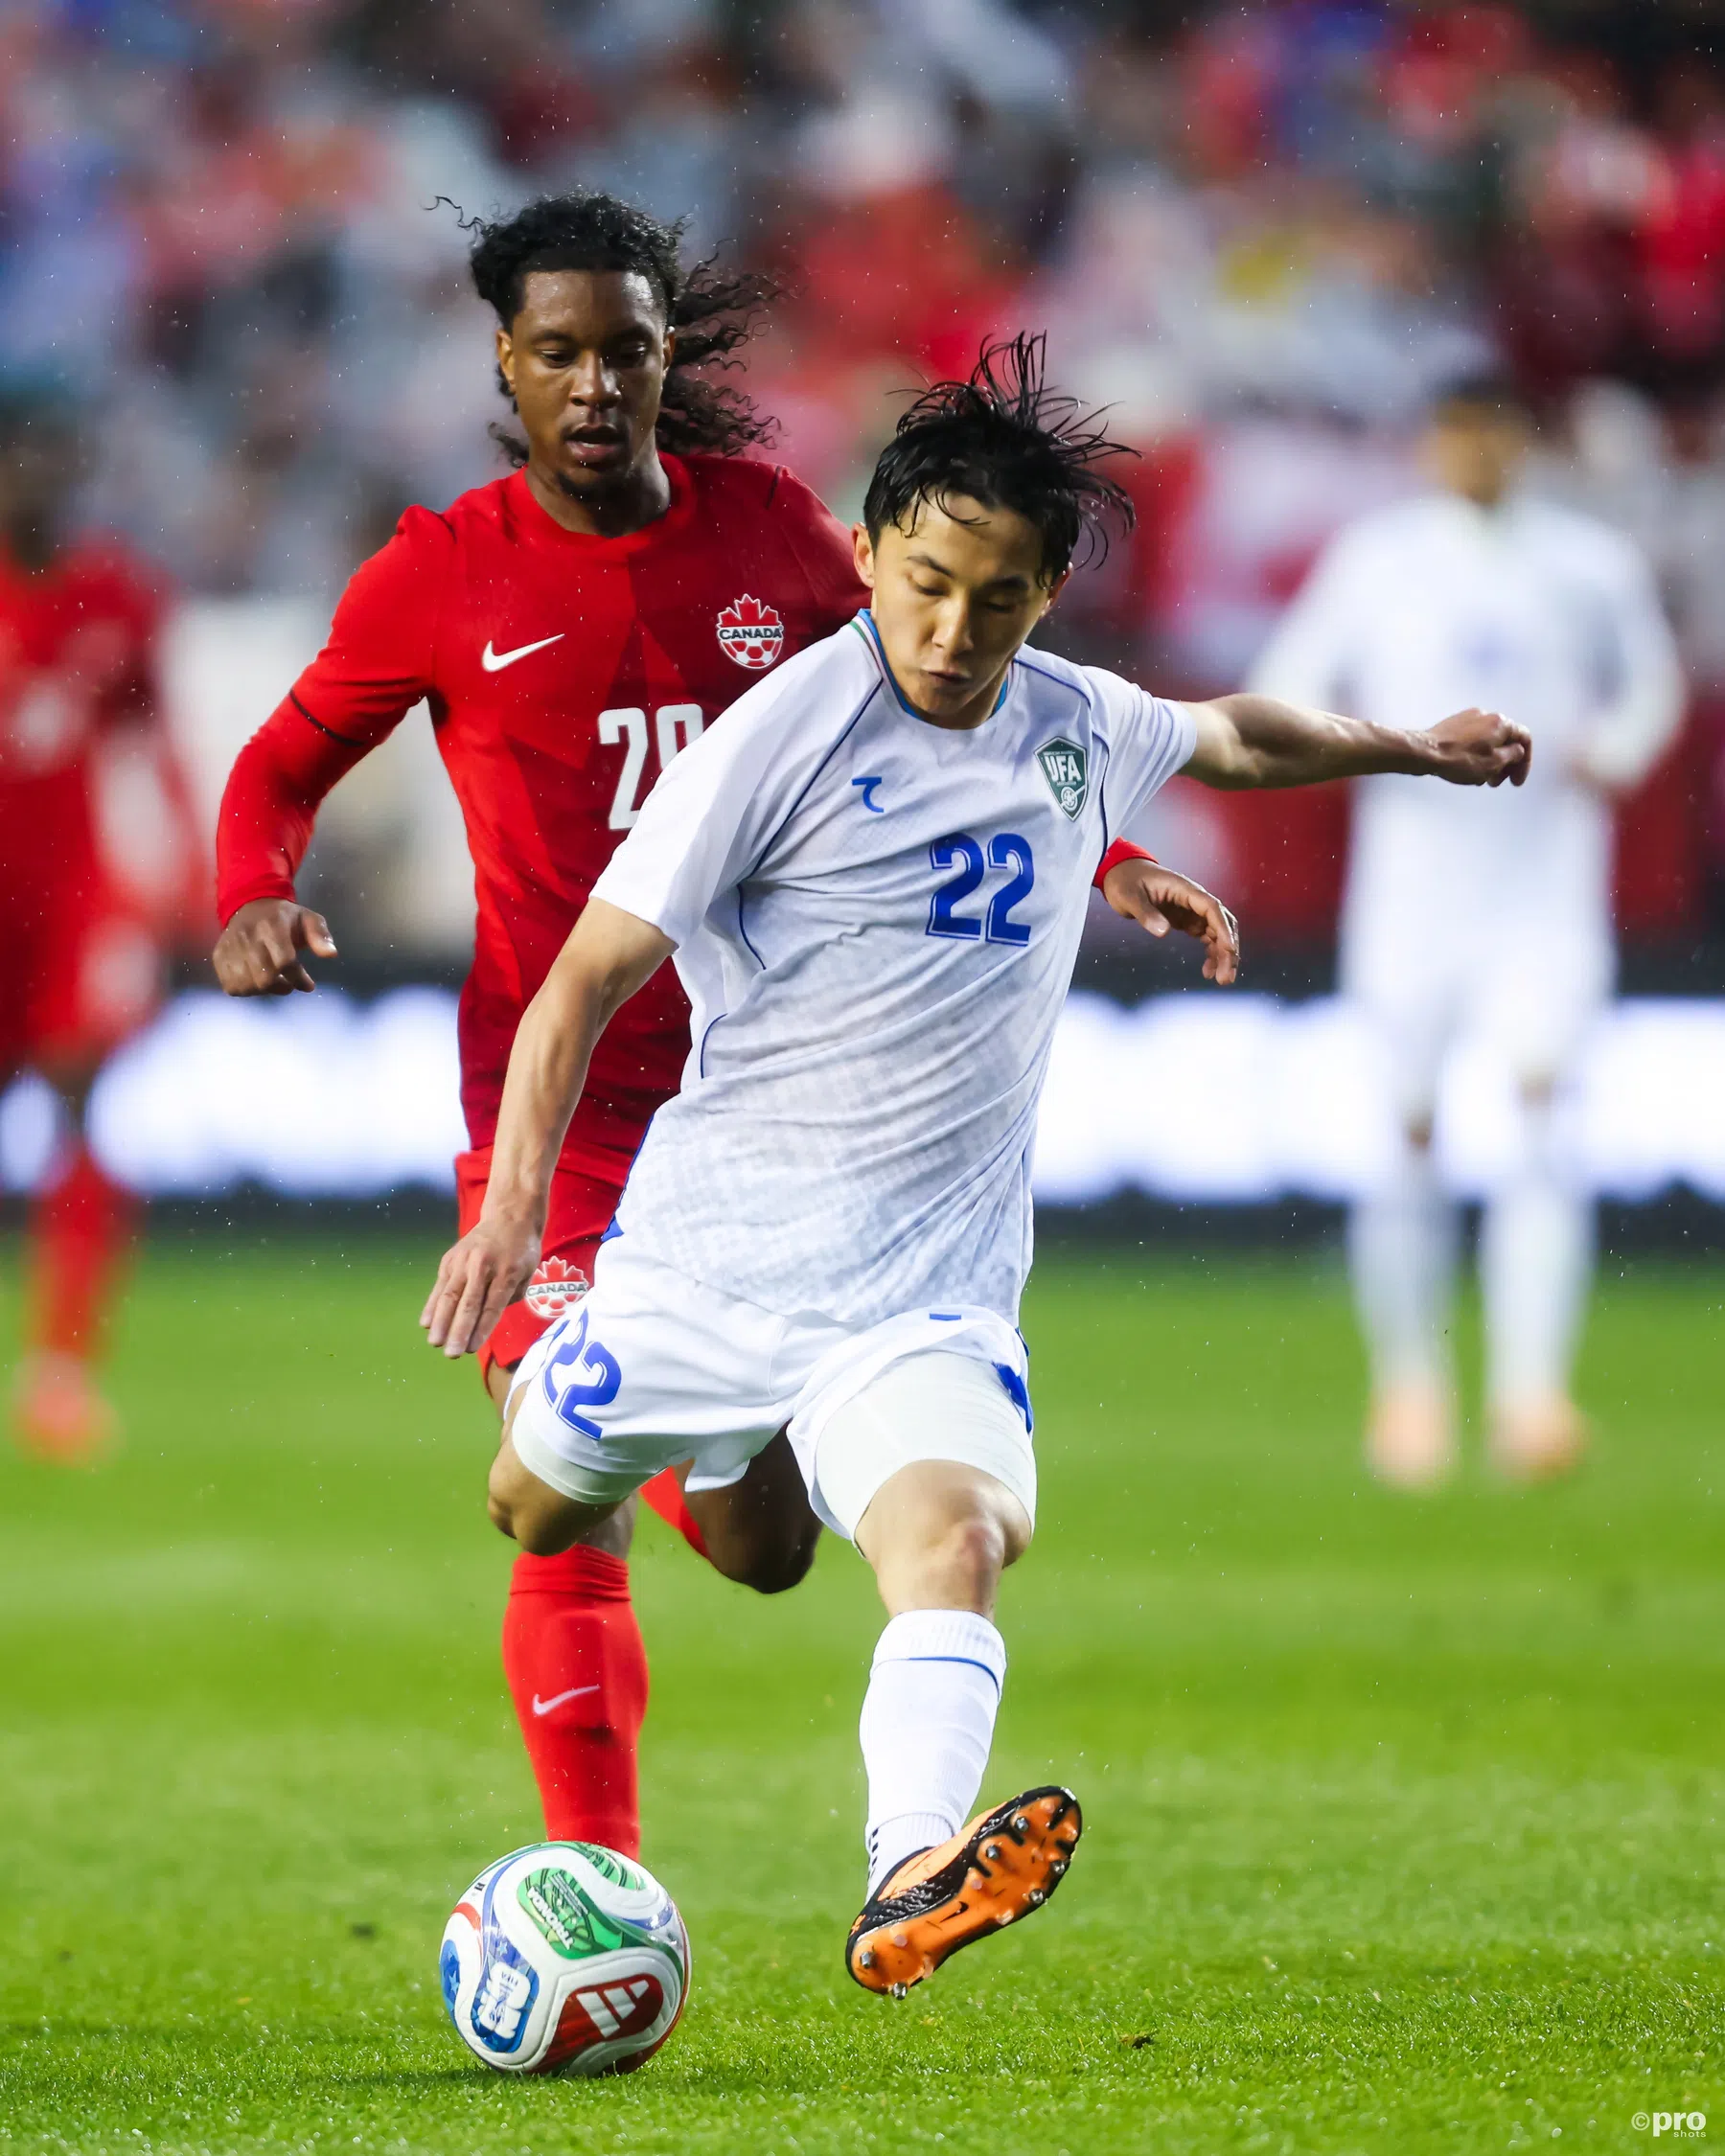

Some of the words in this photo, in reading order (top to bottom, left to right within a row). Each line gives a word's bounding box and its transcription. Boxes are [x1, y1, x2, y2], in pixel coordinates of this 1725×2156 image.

[719, 627, 782, 640] CANADA
[1044, 754, 1082, 782] UFA
[925, 832, 1035, 947] 22
[526, 1282, 587, 1296] CANADA
